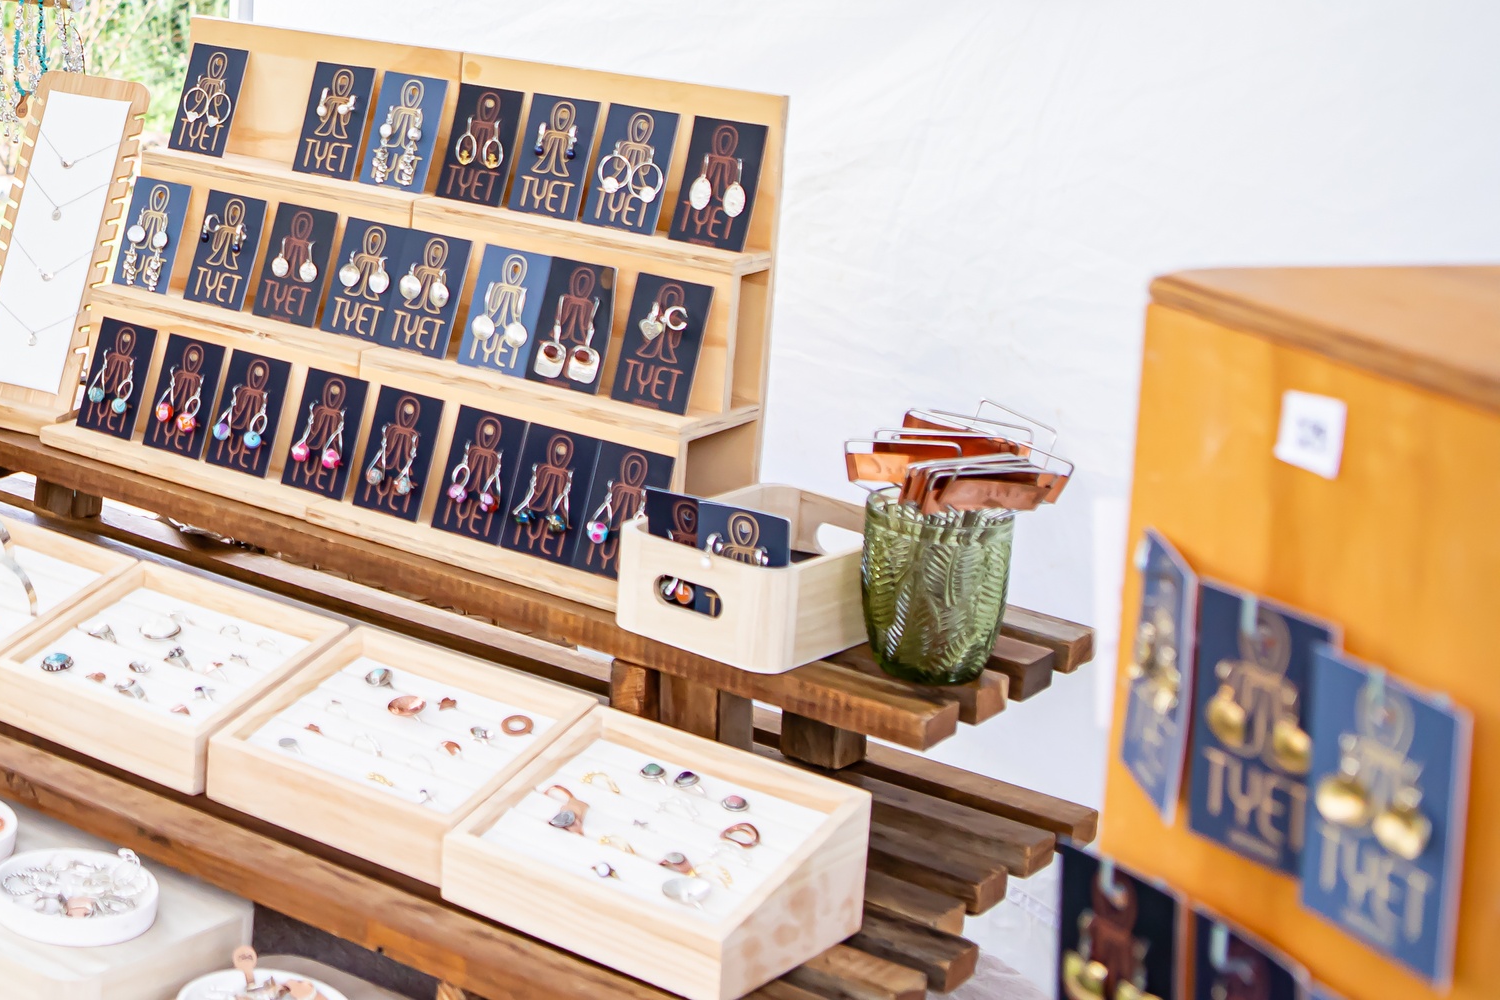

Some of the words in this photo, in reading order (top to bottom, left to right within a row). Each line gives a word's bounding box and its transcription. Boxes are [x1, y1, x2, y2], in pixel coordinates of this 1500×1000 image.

[304, 138, 353, 173] TYET
[446, 164, 500, 202] TYET
[520, 175, 575, 214] TYET
[194, 266, 242, 304] TYET
[262, 279, 311, 316] TYET
[331, 296, 384, 336] TYET
[391, 309, 445, 350] TYET
[623, 359, 683, 402] TYET
